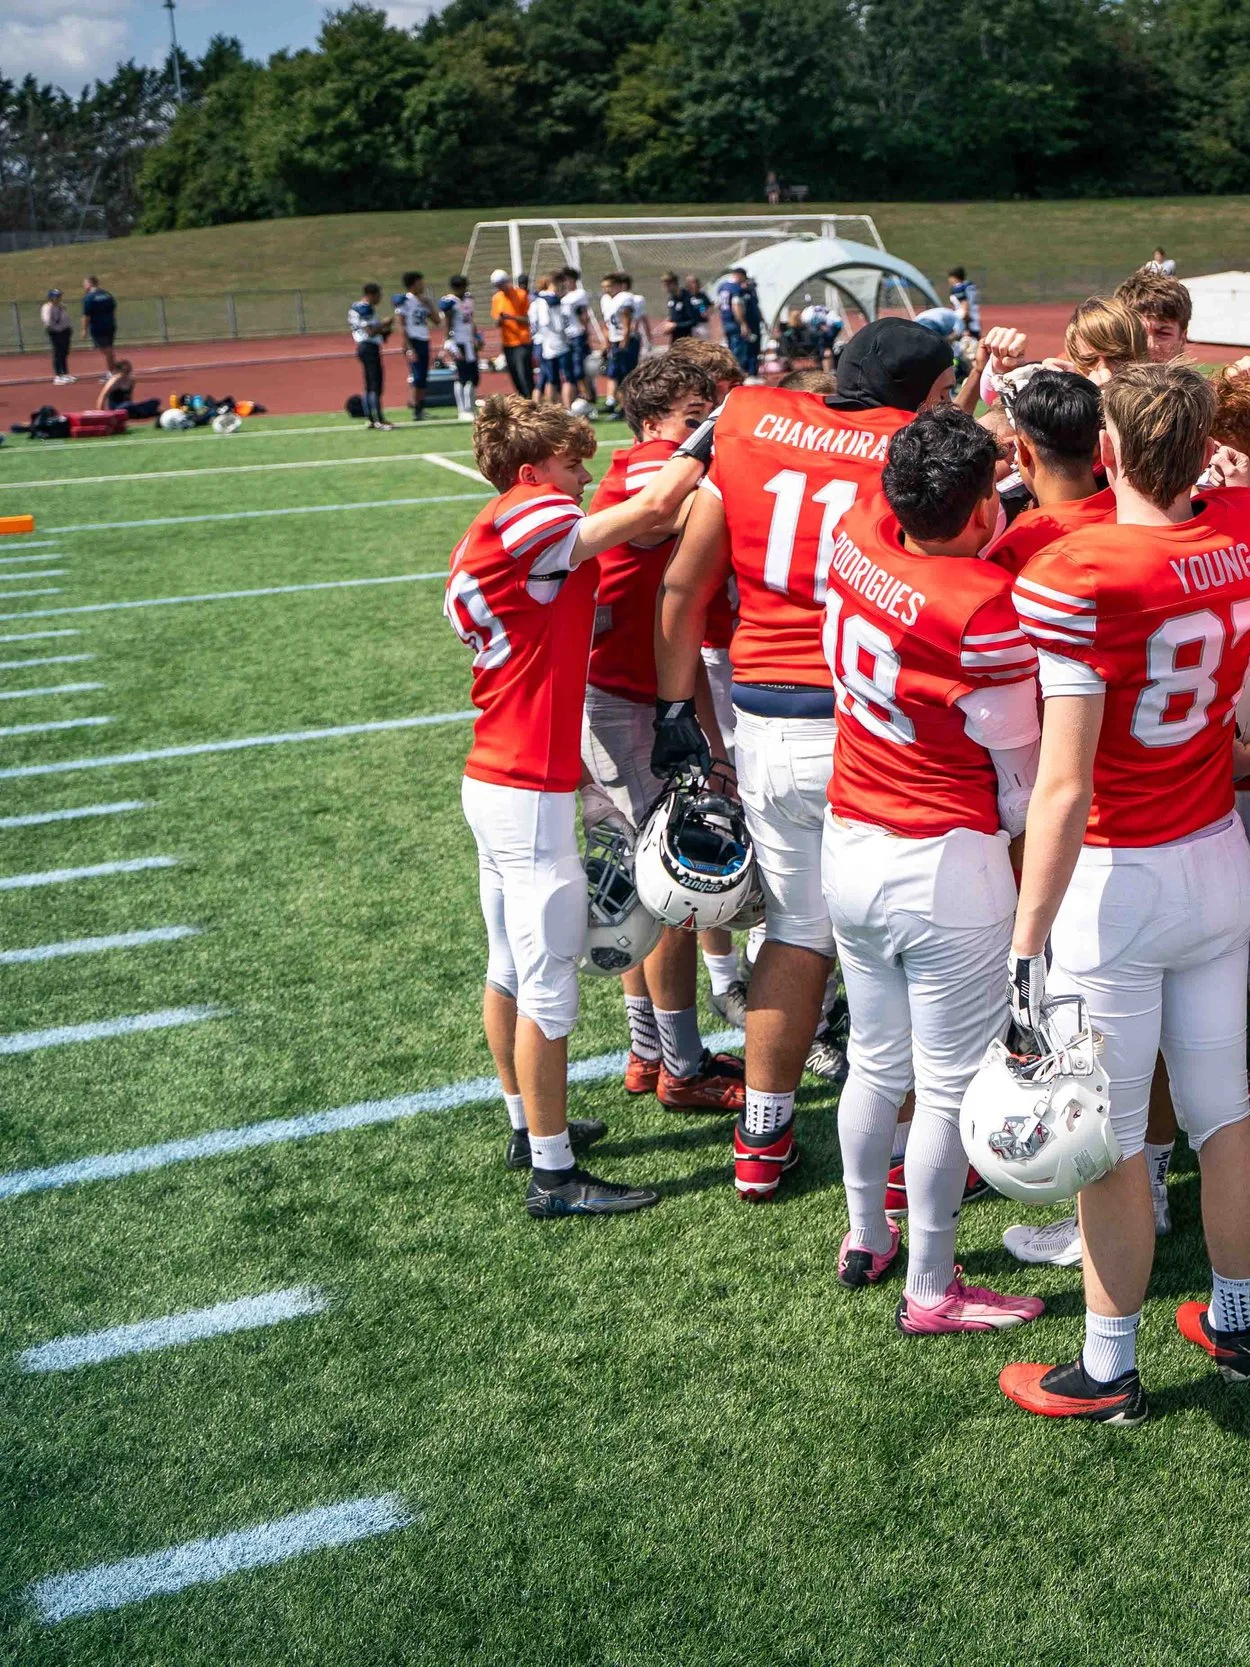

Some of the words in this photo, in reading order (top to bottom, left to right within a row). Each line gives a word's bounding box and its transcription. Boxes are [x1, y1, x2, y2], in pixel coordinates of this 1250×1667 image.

[754, 414, 889, 462] CHANAKIRA
[763, 469, 859, 605] 11
[821, 587, 918, 746] 18
